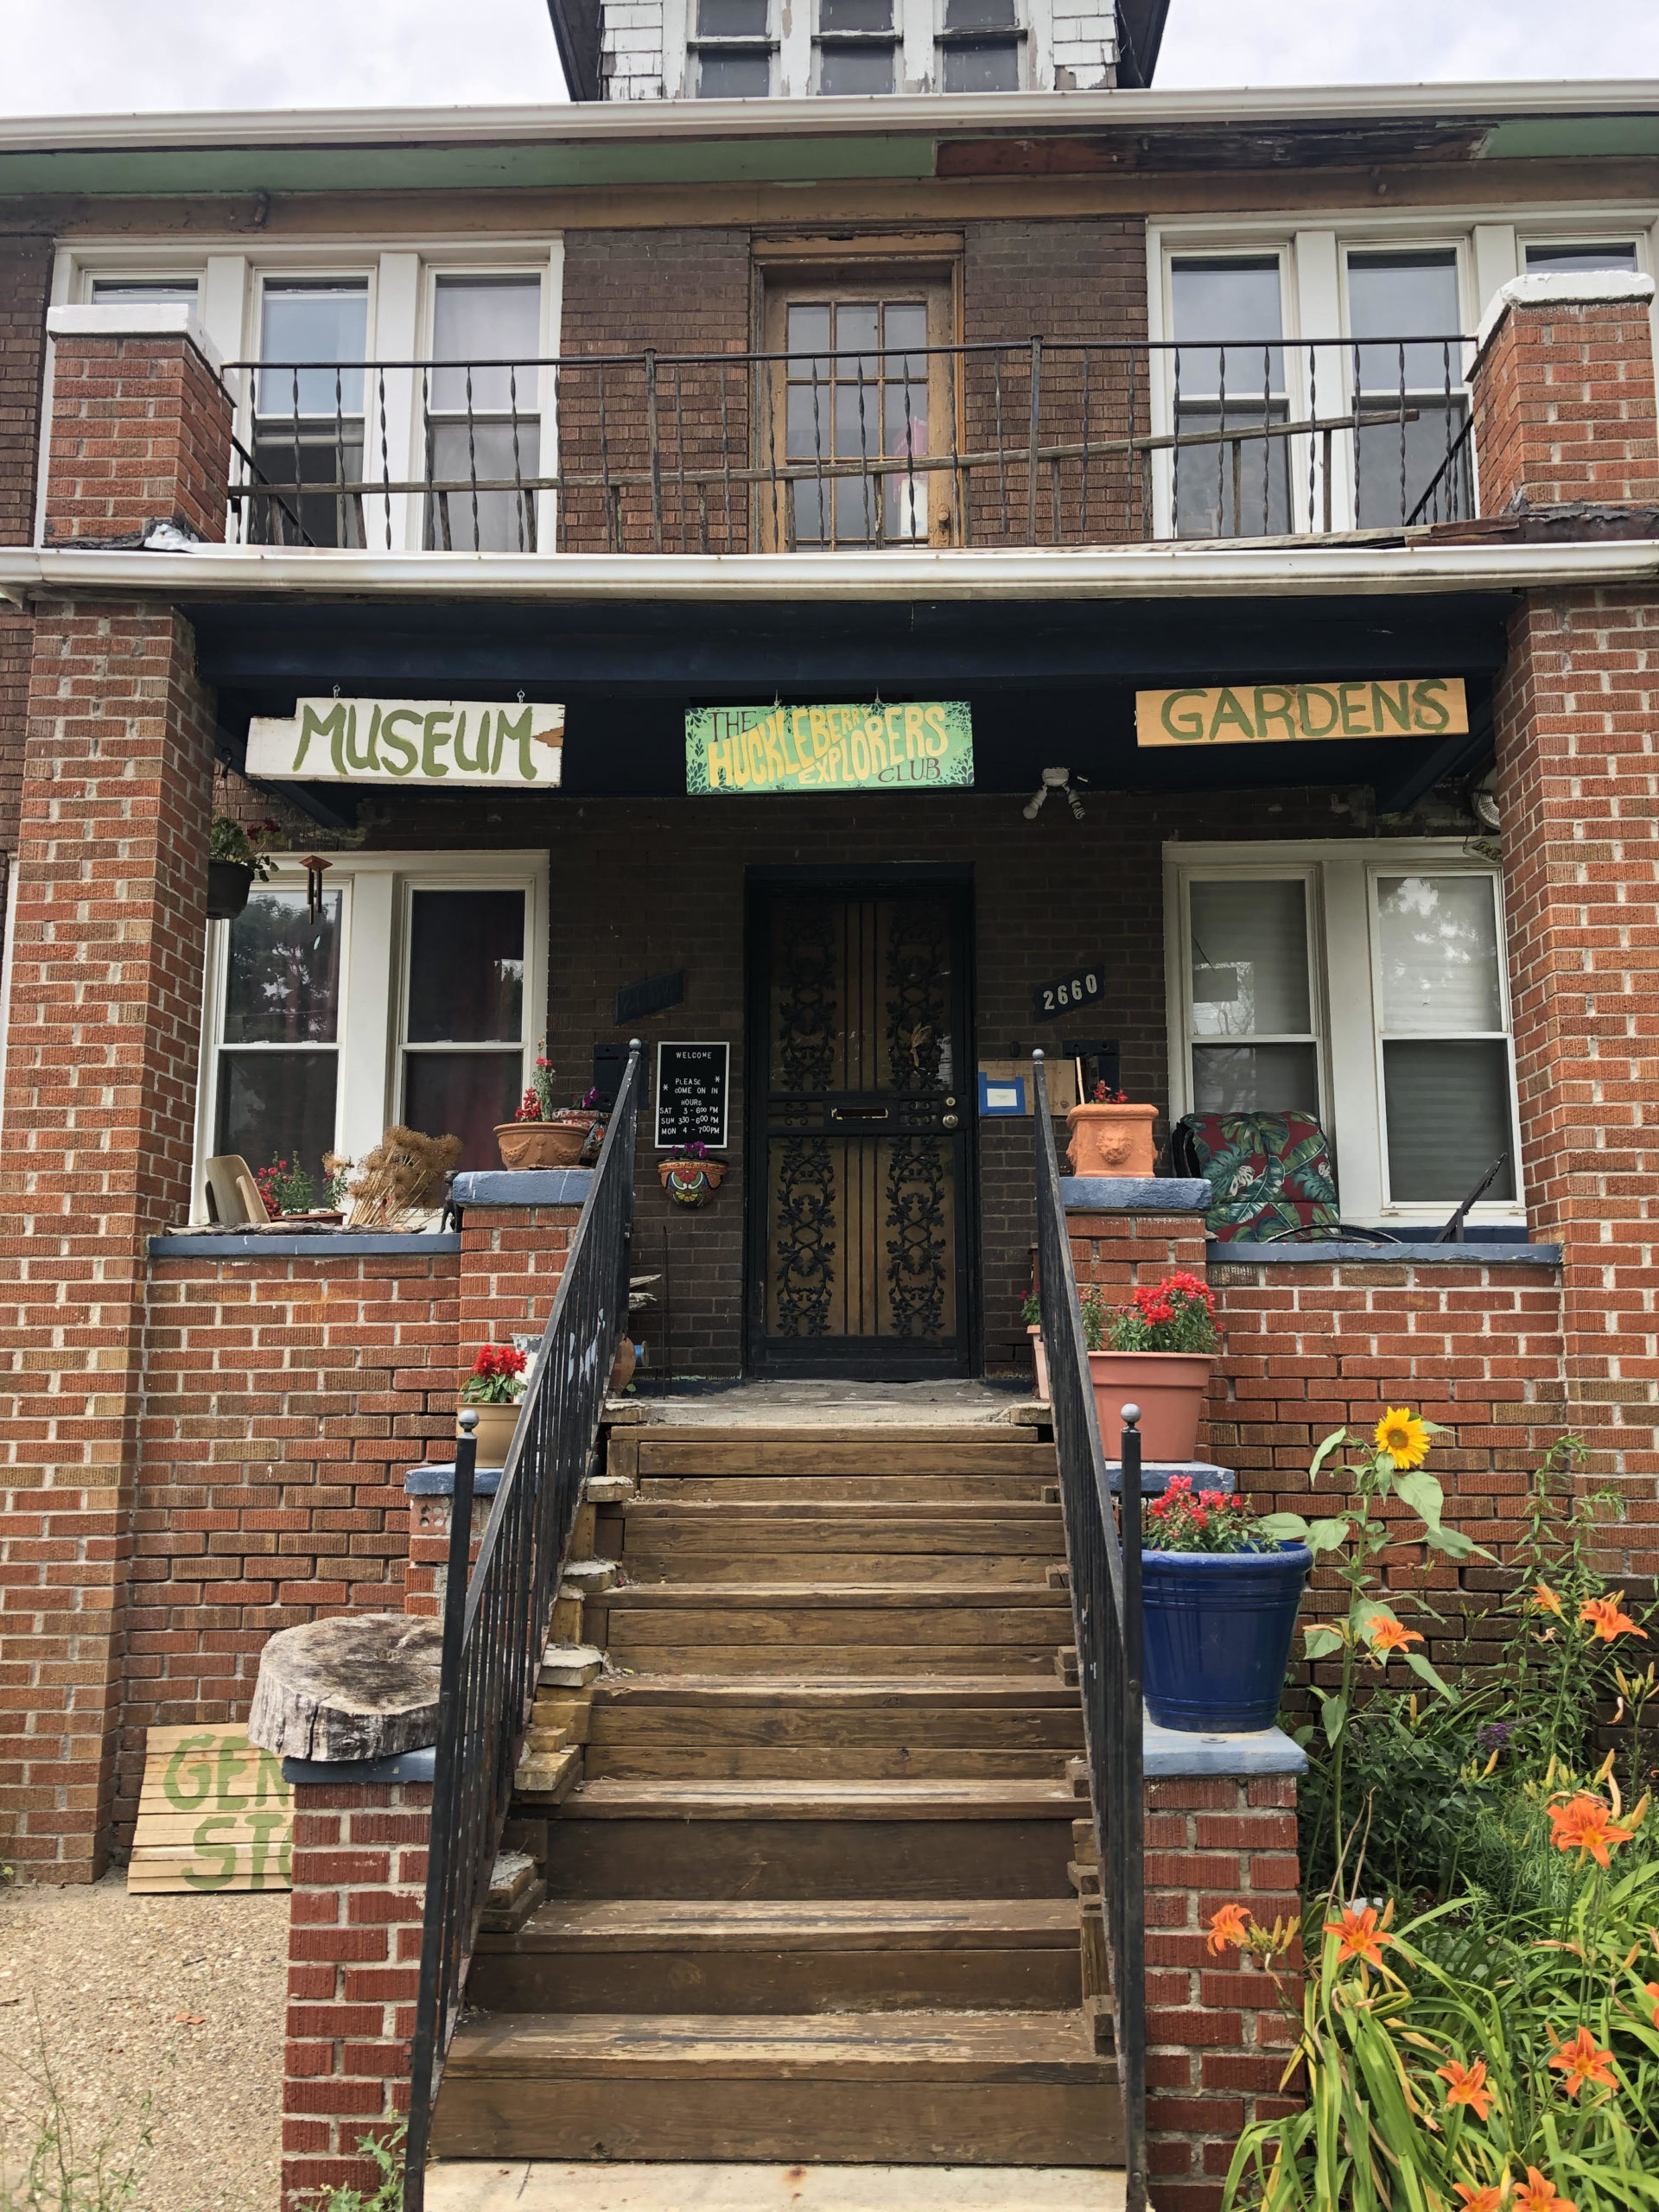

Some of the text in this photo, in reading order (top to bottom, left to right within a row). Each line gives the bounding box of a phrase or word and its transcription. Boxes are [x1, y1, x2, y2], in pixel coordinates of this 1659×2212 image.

[707, 710, 758, 742] THE
[1160, 678, 1451, 741] GARDENS
[292, 702, 537, 780] MUSEUM
[708, 709, 872, 787] HUCKLEBERRY
[798, 705, 949, 785] EXPLORERS
[877, 757, 941, 783] CLUB
[1043, 974, 1097, 1009] 2660
[661, 1127, 677, 1135] MON
[710, 1116, 719, 1124] PM
